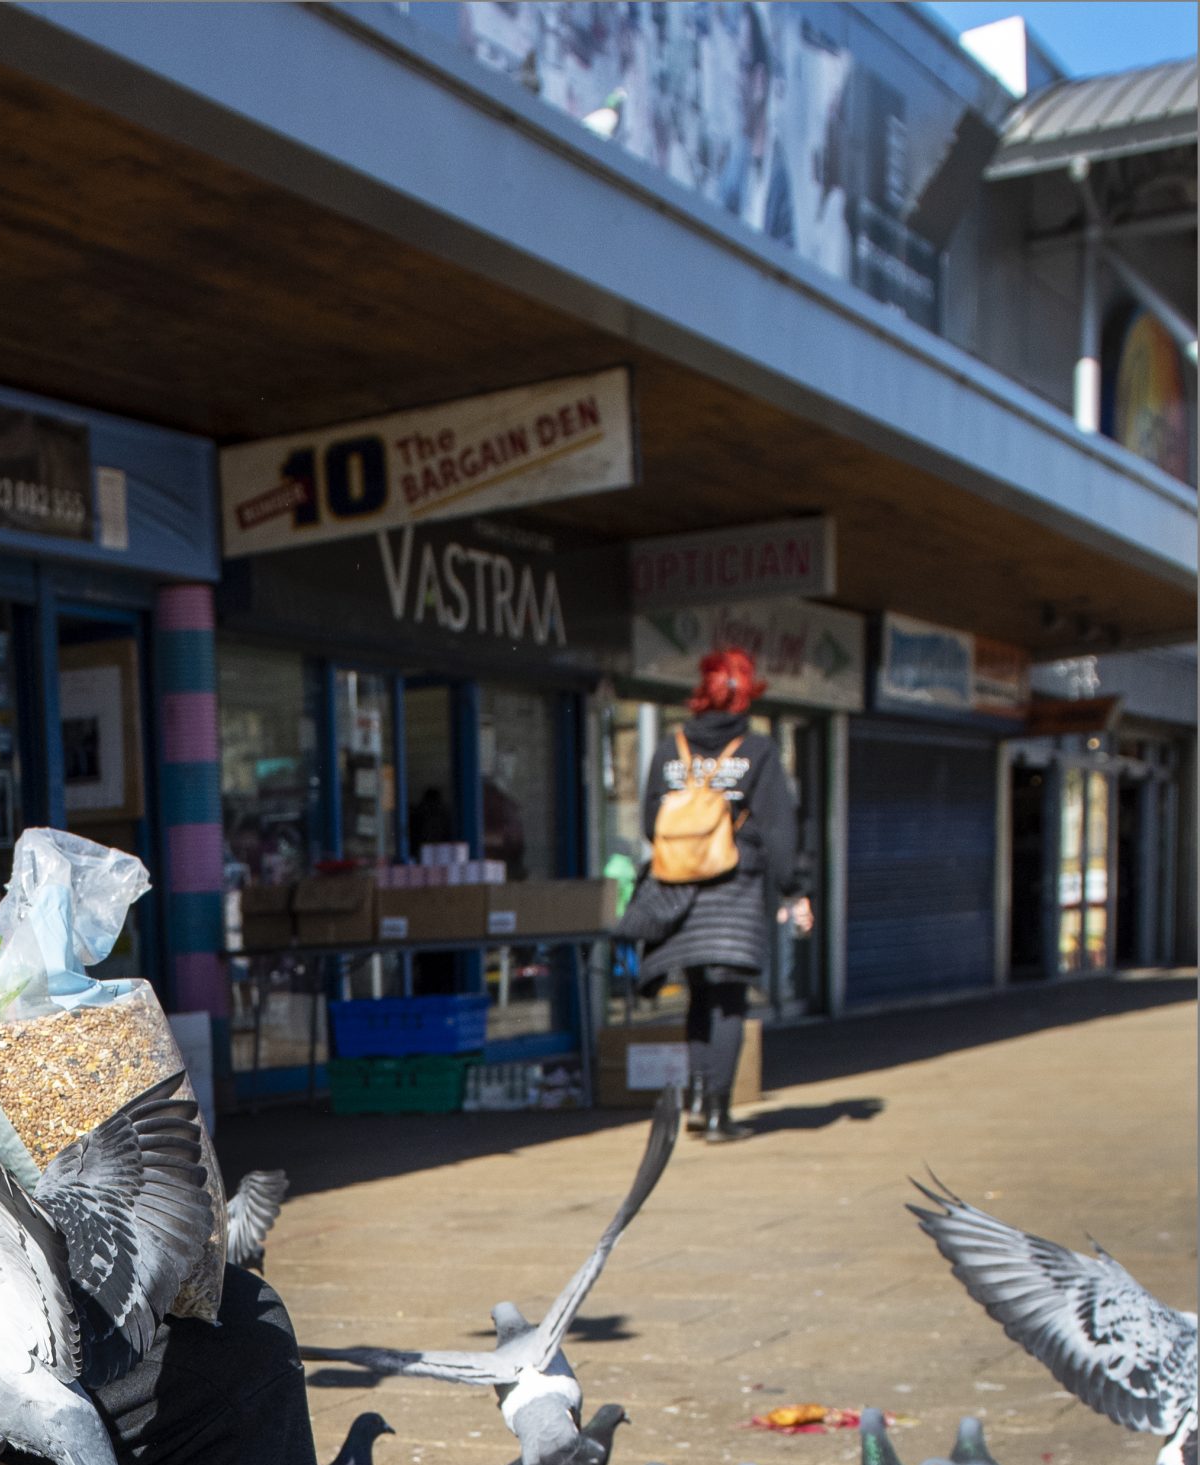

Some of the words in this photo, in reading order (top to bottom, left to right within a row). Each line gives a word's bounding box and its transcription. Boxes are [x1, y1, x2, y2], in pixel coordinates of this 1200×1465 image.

[281, 432, 390, 527] 10
[394, 427, 456, 466] The
[400, 424, 530, 505] BARGAIN
[536, 394, 601, 448] DEN
[632, 537, 812, 594] OPTICIAN
